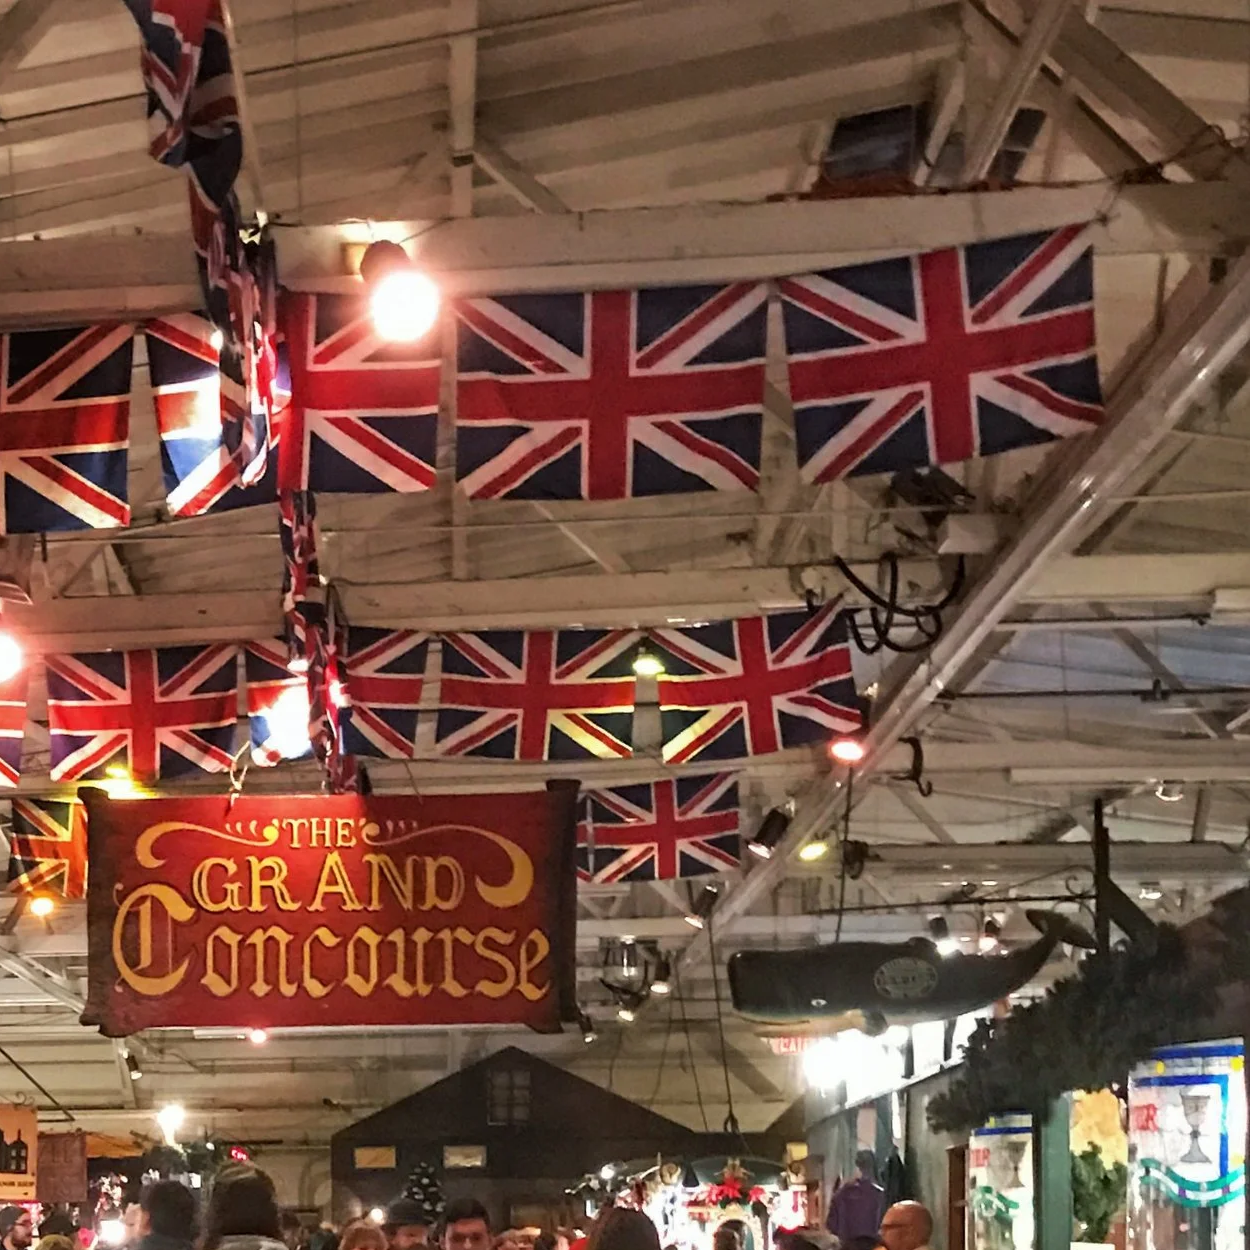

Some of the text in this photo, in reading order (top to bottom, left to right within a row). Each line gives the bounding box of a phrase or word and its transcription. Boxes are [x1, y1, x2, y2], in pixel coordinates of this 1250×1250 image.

[285, 818, 355, 849] THE
[192, 851, 465, 913] GRAND
[111, 882, 551, 1001] Concourse
